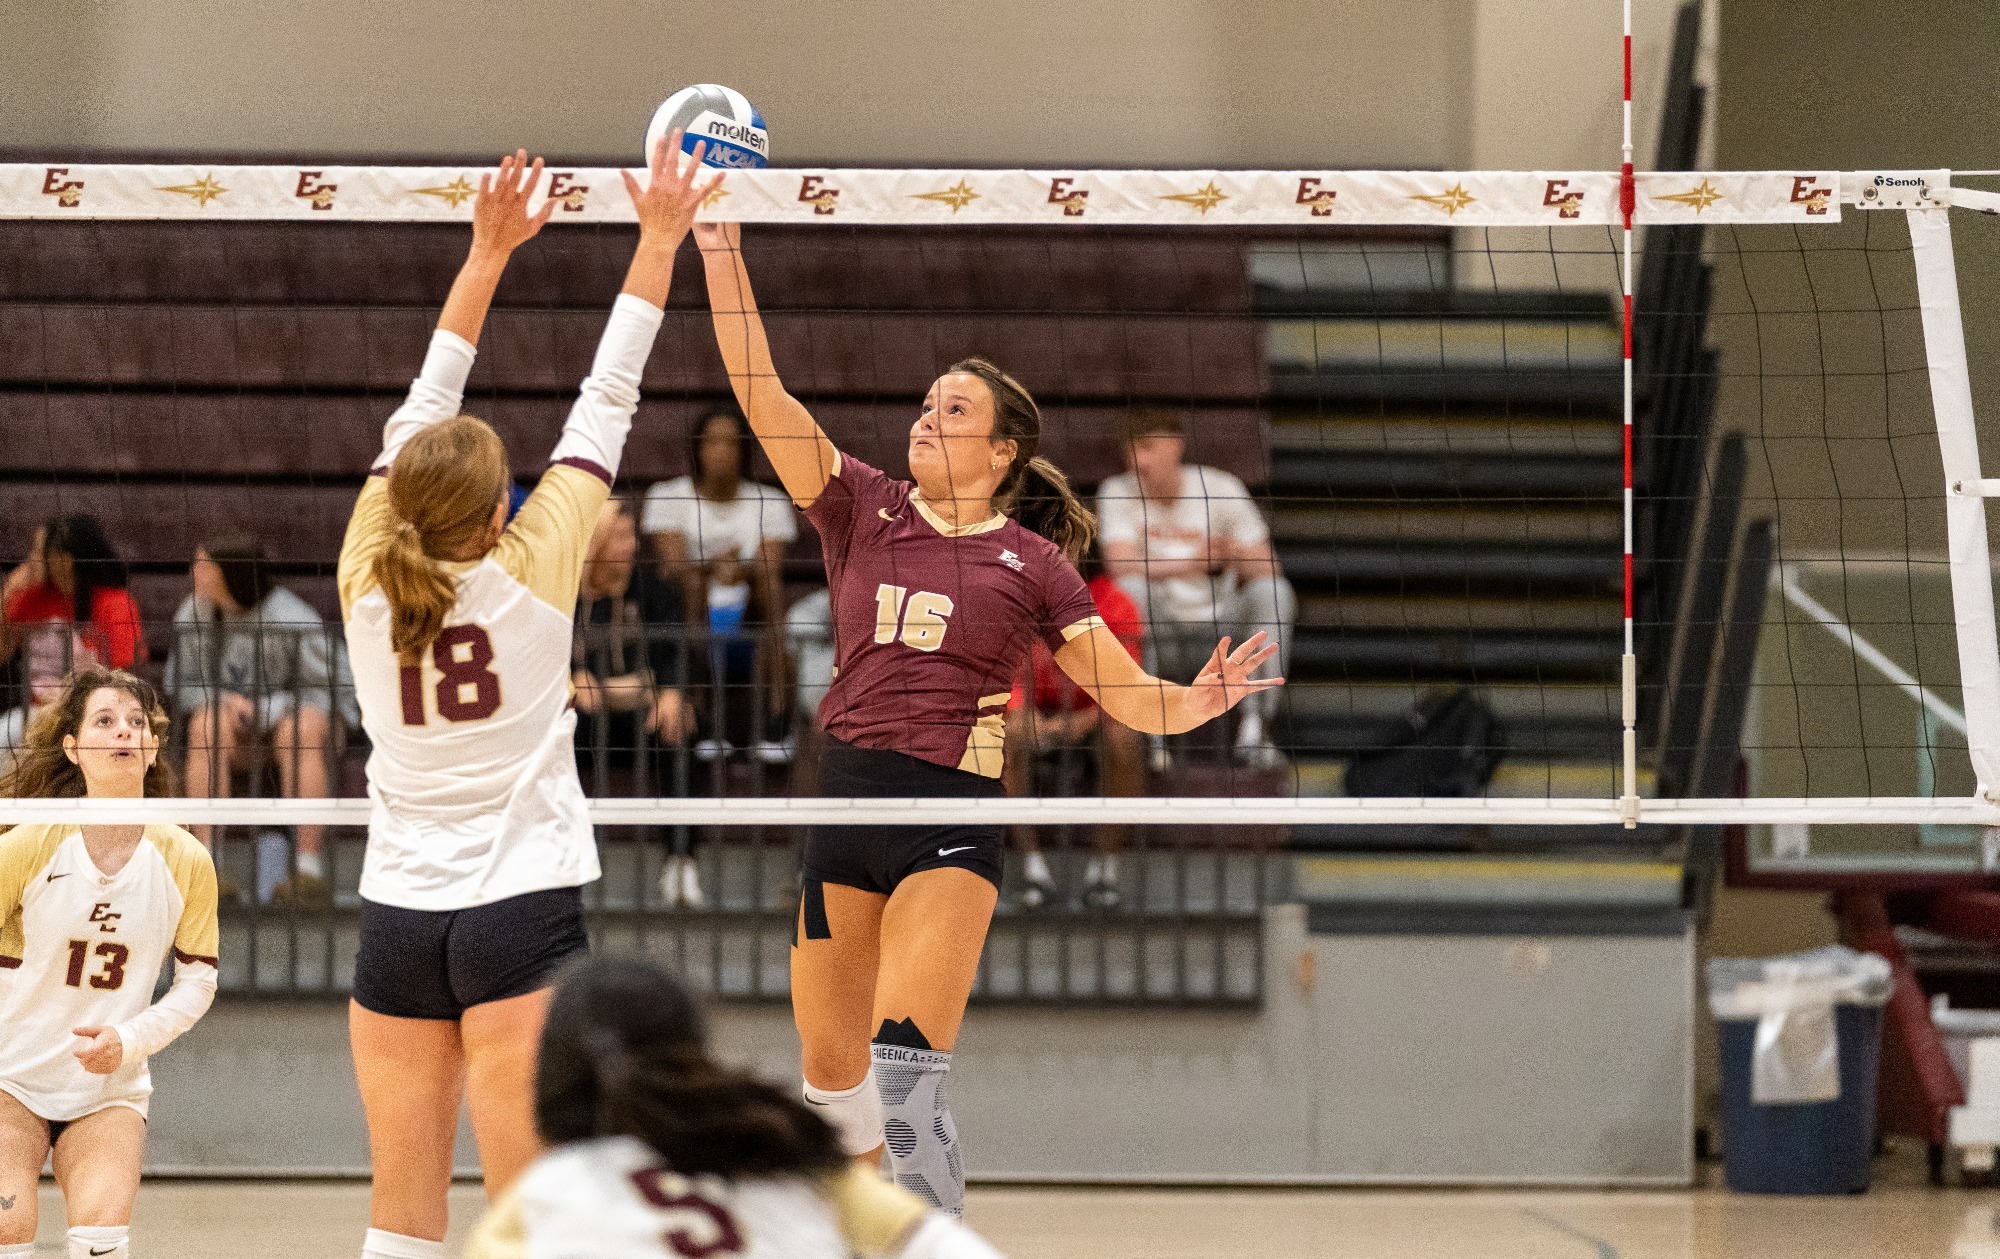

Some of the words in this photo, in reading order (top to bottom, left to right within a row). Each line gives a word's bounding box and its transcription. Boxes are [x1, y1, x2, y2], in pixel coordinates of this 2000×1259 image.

[708, 121, 765, 151] molten
[1885, 177, 1925, 187] Senoh
[875, 583, 955, 652] 16
[398, 622, 503, 727] 18
[65, 939, 130, 991] 13
